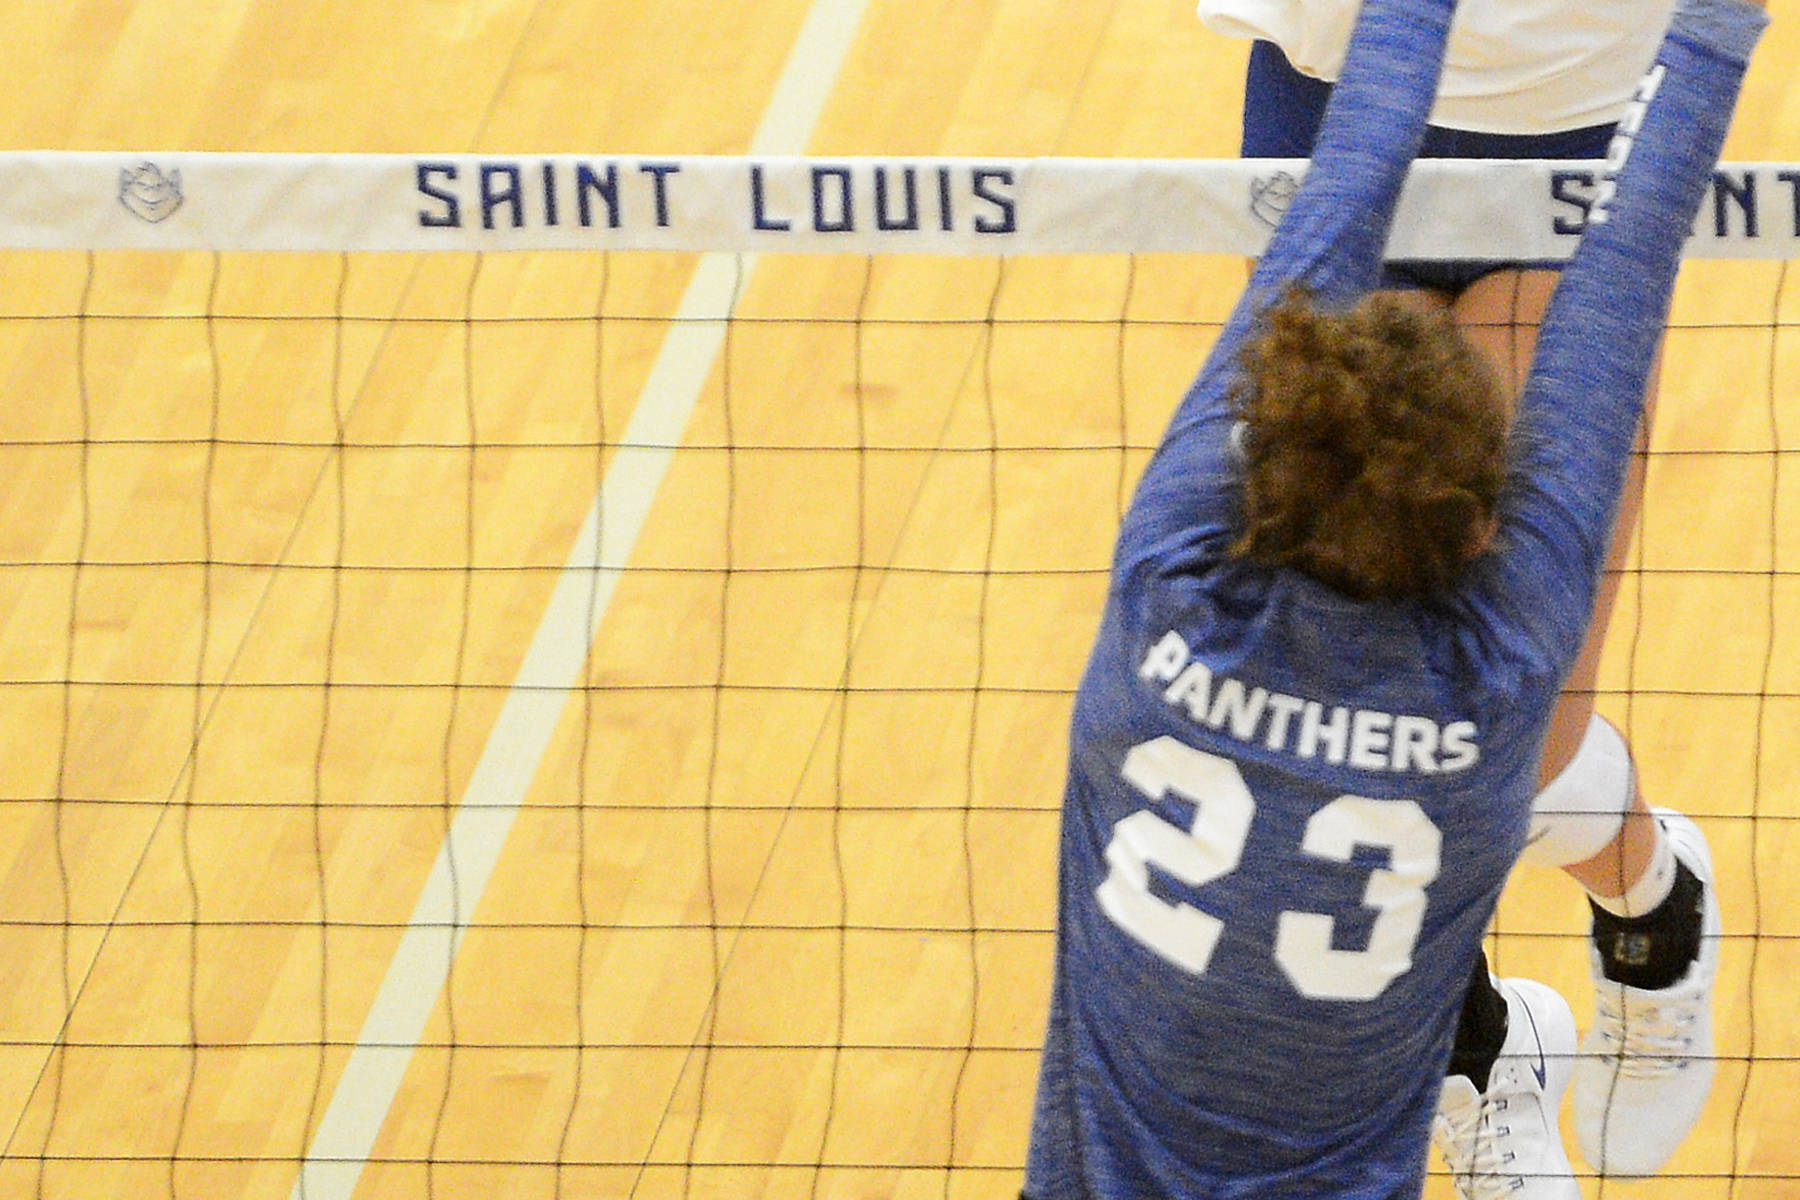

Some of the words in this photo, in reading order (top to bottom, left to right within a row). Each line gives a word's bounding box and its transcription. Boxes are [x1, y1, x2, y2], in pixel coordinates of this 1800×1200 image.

[416, 161, 681, 229] SAINT
[750, 163, 1016, 233] LOUIS
[1138, 629, 1480, 775] PANTHERS
[1096, 734, 1443, 1001] 23
